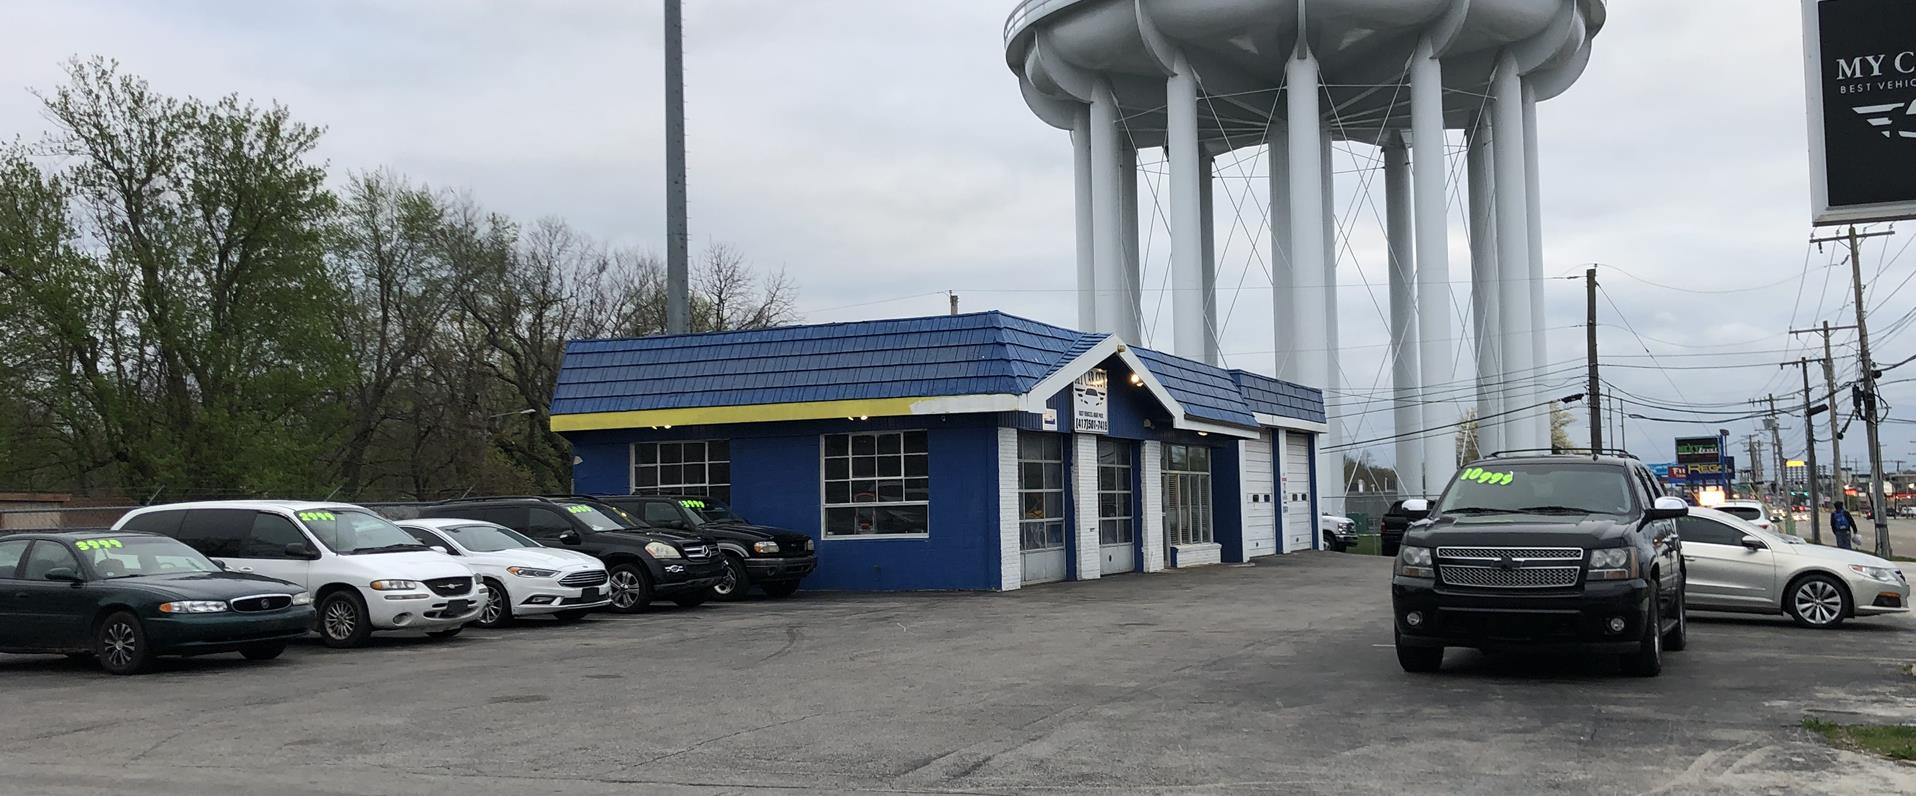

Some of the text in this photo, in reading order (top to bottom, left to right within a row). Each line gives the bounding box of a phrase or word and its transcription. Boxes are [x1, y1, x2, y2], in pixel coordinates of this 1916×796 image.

[1836, 54, 1886, 80] MY
[1840, 83, 1871, 94] BEST
[1461, 468, 1514, 485] 10999
